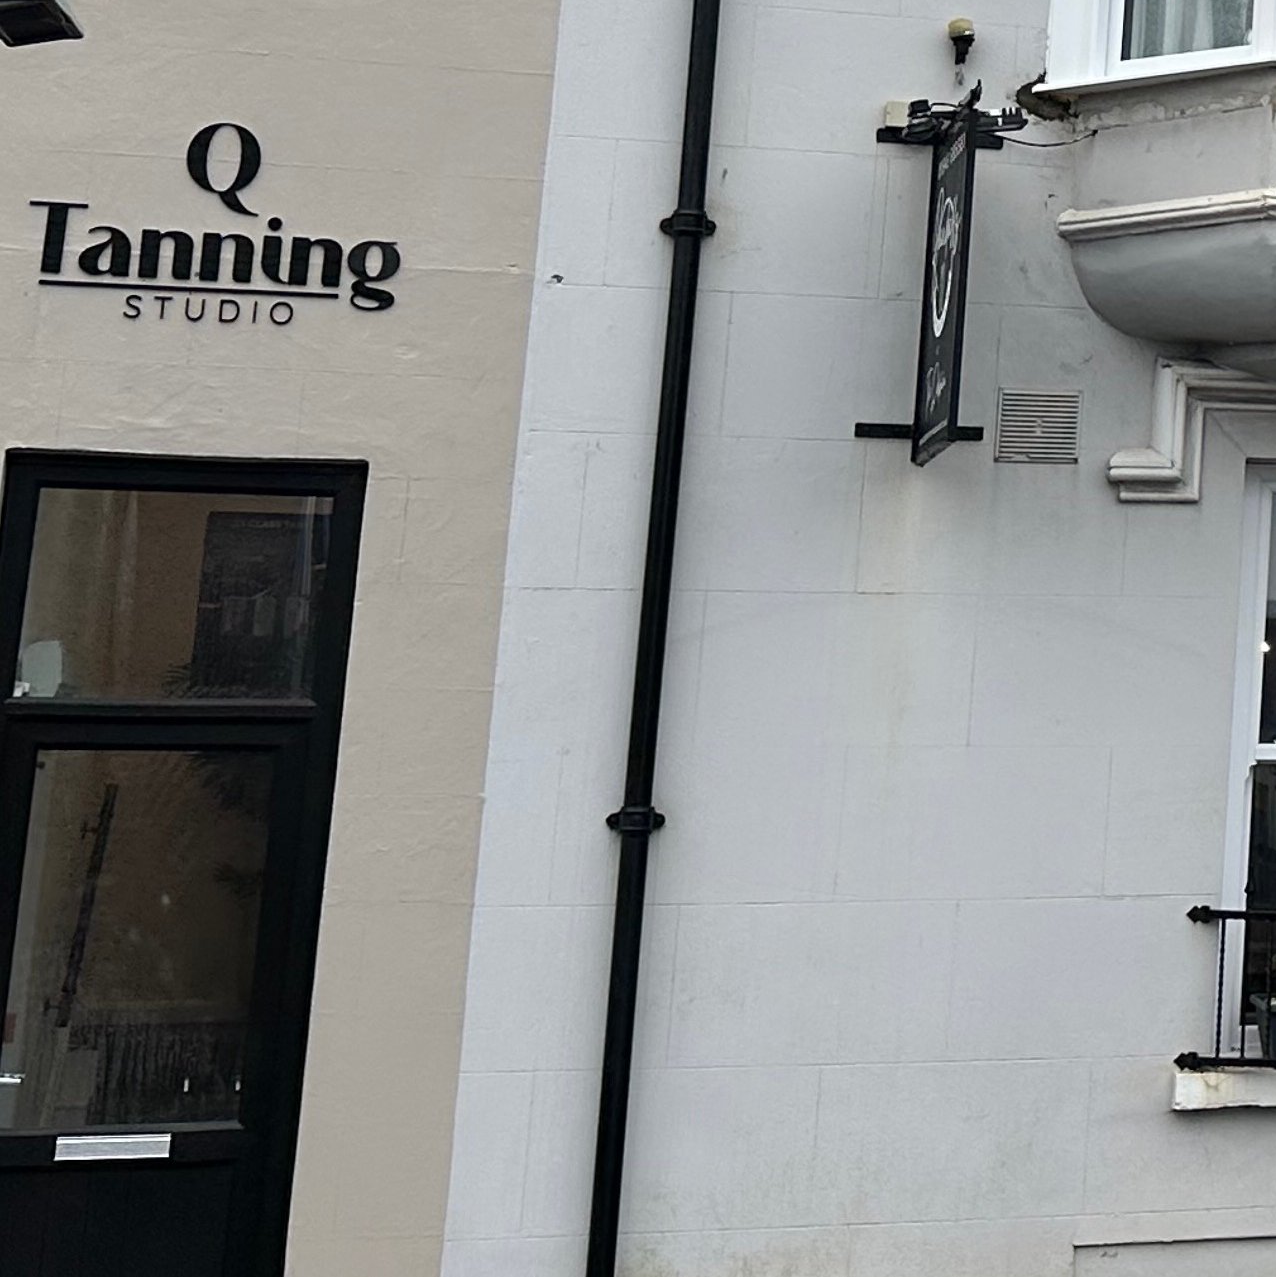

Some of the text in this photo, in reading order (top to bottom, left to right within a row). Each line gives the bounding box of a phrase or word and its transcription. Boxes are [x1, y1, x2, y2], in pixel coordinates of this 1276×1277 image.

[186, 122, 262, 216] Q
[30, 199, 401, 311] Tanning
[123, 294, 294, 325] STUDIO
